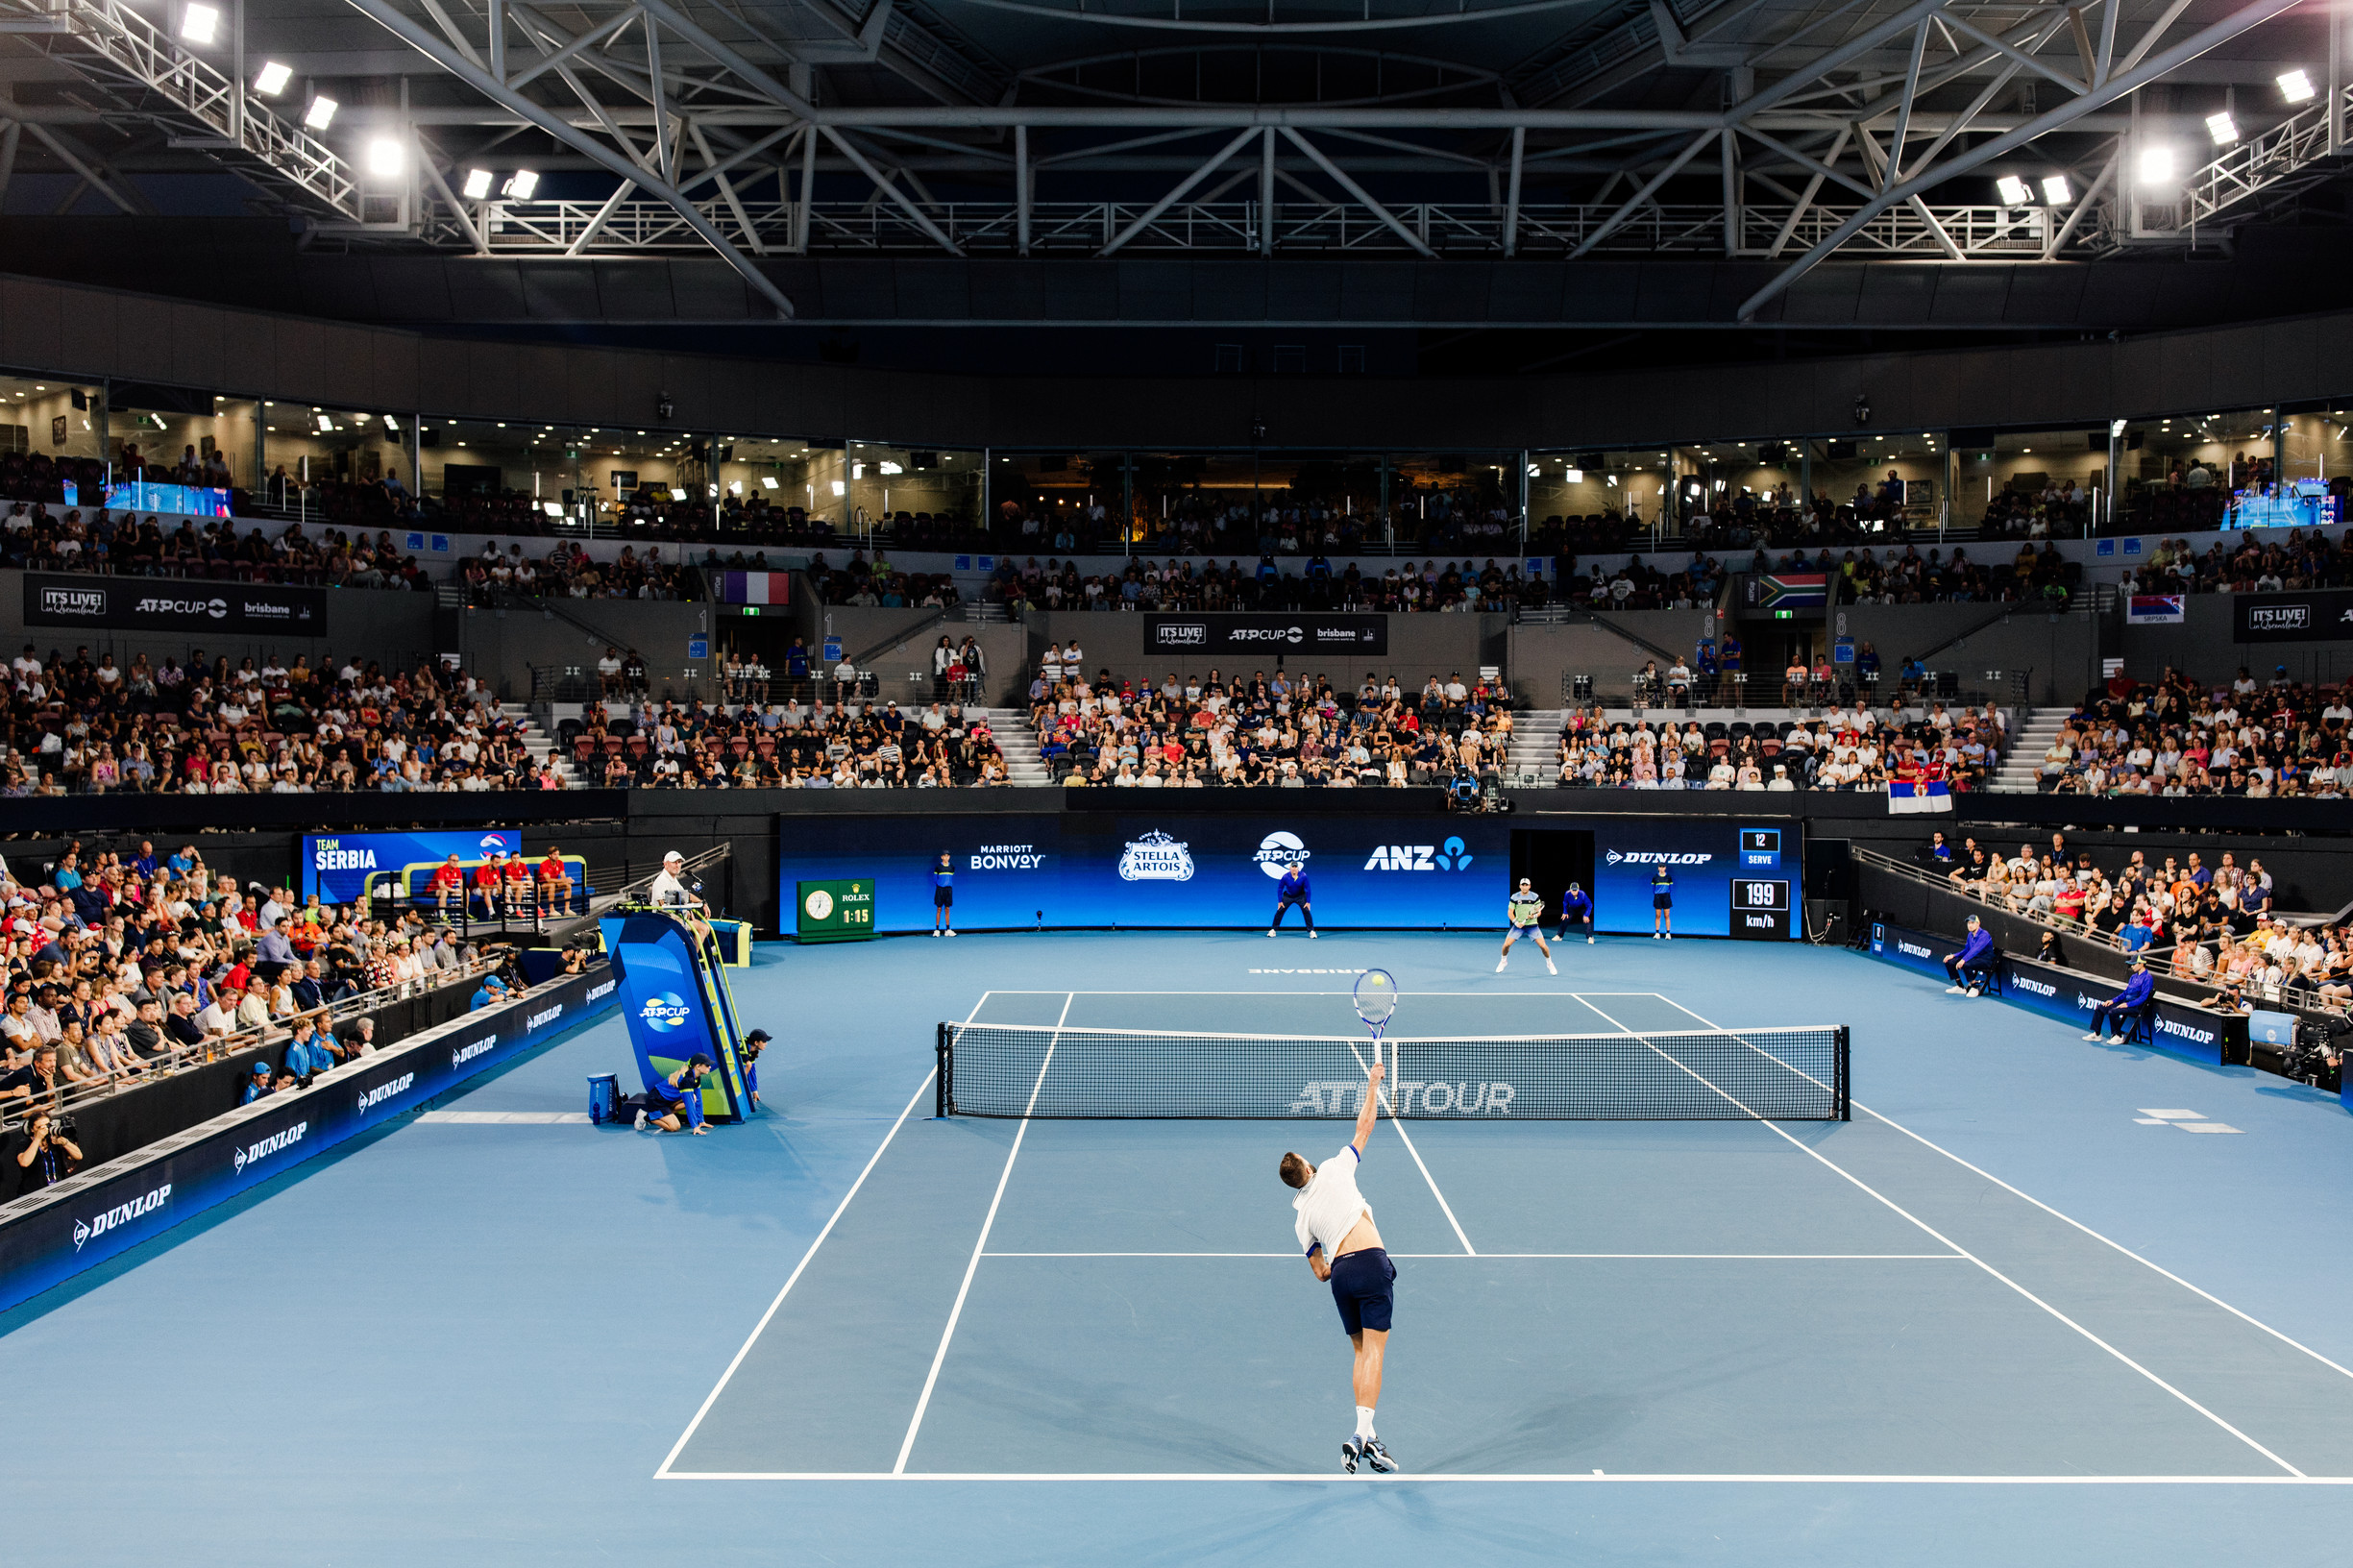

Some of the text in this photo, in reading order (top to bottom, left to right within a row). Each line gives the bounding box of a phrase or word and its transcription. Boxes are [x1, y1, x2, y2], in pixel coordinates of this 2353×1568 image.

[46, 592, 102, 606] IT'S LIVE!
[54, 601, 99, 615] Queensland
[135, 599, 207, 614] ATP CUP
[245, 601, 290, 615] brisbane
[699, 610, 707, 632] 1
[2253, 608, 2306, 622] IT'S LIVE!
[824, 613, 832, 636] 1
[1703, 615, 1714, 638] 8
[1836, 612, 1847, 635] 8
[2261, 617, 2303, 630] Queensland
[1160, 627, 1203, 637] IT'S LIVE!
[1229, 629, 1287, 640] ATP CUP
[1317, 628, 1356, 637] brisbane
[1166, 634, 1201, 645] Queensland
[316, 839, 339, 850] TEAM
[1754, 833, 1766, 846] 12
[980, 845, 1033, 854] MARRIOTT
[1134, 851, 1180, 861] STELLA
[1252, 849, 1311, 861] ATP CUP
[315, 849, 377, 870] SERBIA
[970, 855, 1042, 870] BONVOY
[1363, 845, 1434, 870] ANZ
[1623, 851, 1712, 865] DUNLOP
[1748, 854, 1772, 865] SERVE
[1133, 862, 1181, 871] ARTOIS
[842, 894, 870, 902] ROLEX
[1746, 882, 1775, 906] 199
[843, 909, 869, 923] 1:15
[1746, 914, 1775, 928] km/h
[1903, 942, 1931, 959] DUNLOP
[590, 978, 616, 1001] DUNLOP
[2019, 976, 2056, 997] DUNLOP
[532, 1004, 563, 1028] DUNLOP
[639, 1007, 690, 1017] ATP CUP
[2163, 1019, 2214, 1044] DUNLOP
[459, 1035, 497, 1063] DUNLOP
[368, 1071, 414, 1107] DUNLOP
[1398, 1082, 1515, 1114] TOUR
[247, 1120, 307, 1164] DUNLOP
[90, 1183, 172, 1238] DUNLOP
